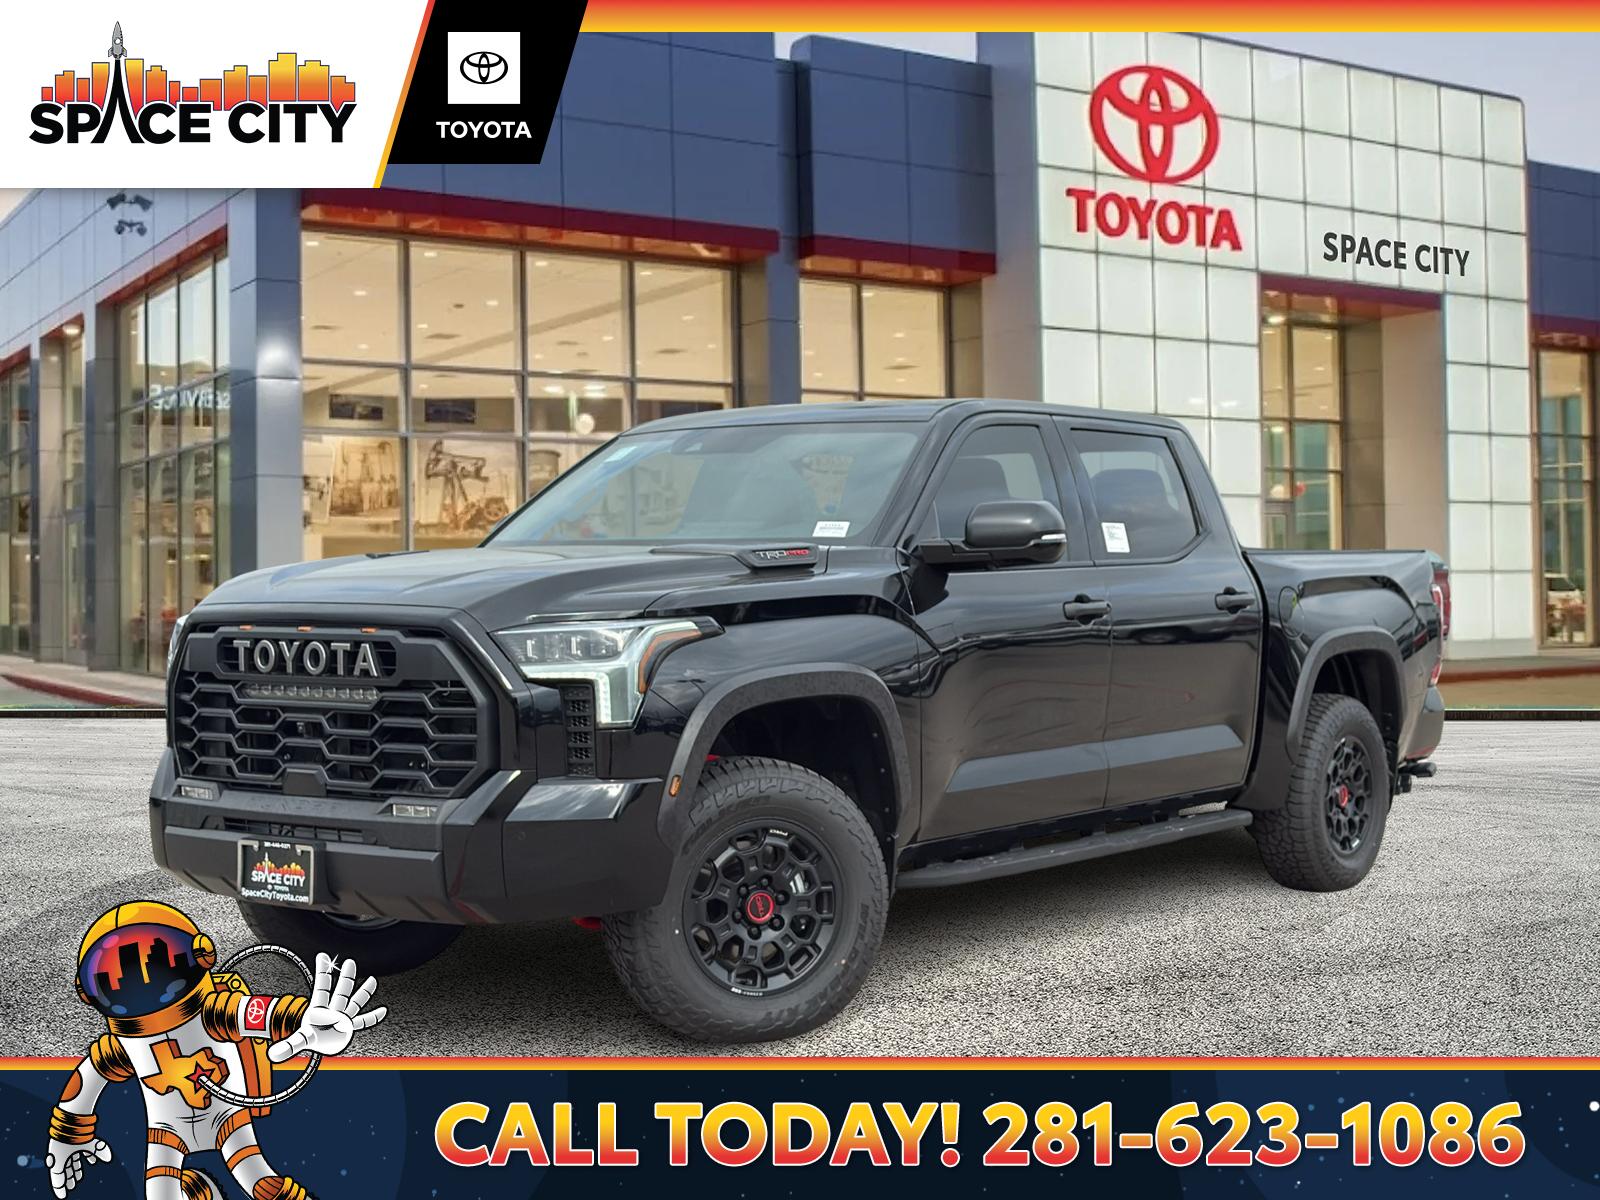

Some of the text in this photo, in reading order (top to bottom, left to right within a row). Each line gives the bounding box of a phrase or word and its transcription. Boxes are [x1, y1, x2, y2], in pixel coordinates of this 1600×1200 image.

[1066, 187, 1243, 252] TOYOTA
[1322, 231, 1471, 278] SPACE CITY
[232, 640, 378, 678] TOYOTA
[241, 887, 309, 902] SpaceCityToyota.com
[251, 870, 305, 887] SPACE CITY
